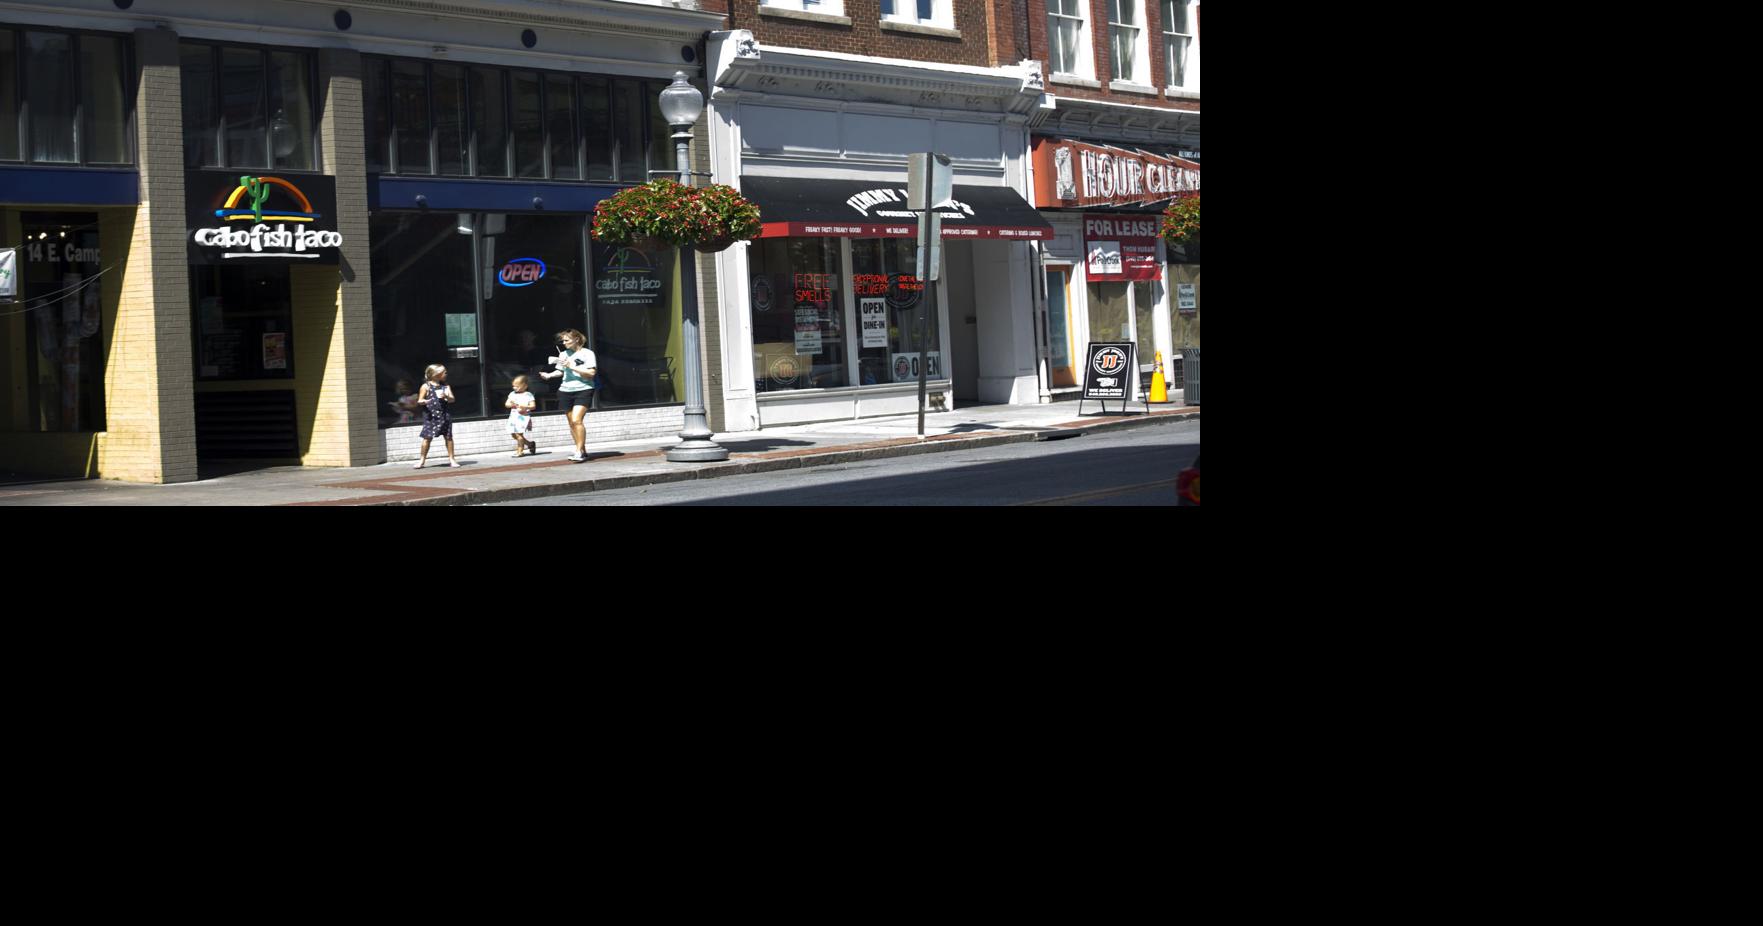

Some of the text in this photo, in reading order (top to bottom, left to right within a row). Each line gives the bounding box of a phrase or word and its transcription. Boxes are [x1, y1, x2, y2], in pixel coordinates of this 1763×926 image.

[1080, 149, 1144, 199] HOUR
[846, 188, 901, 217] JIMMY
[1086, 220, 1156, 237] FOR LEASE
[250, 223, 292, 252] fish
[294, 223, 343, 252] taco
[27, 243, 42, 262] 14
[47, 243, 60, 262] E.
[502, 264, 540, 282] OPEN
[794, 273, 831, 290] FREE
[620, 275, 638, 292] fish
[795, 290, 831, 302] SMELLS
[863, 303, 884, 314] OPEN
[863, 321, 885, 330] DINE-IN
[911, 356, 940, 377] OEN
